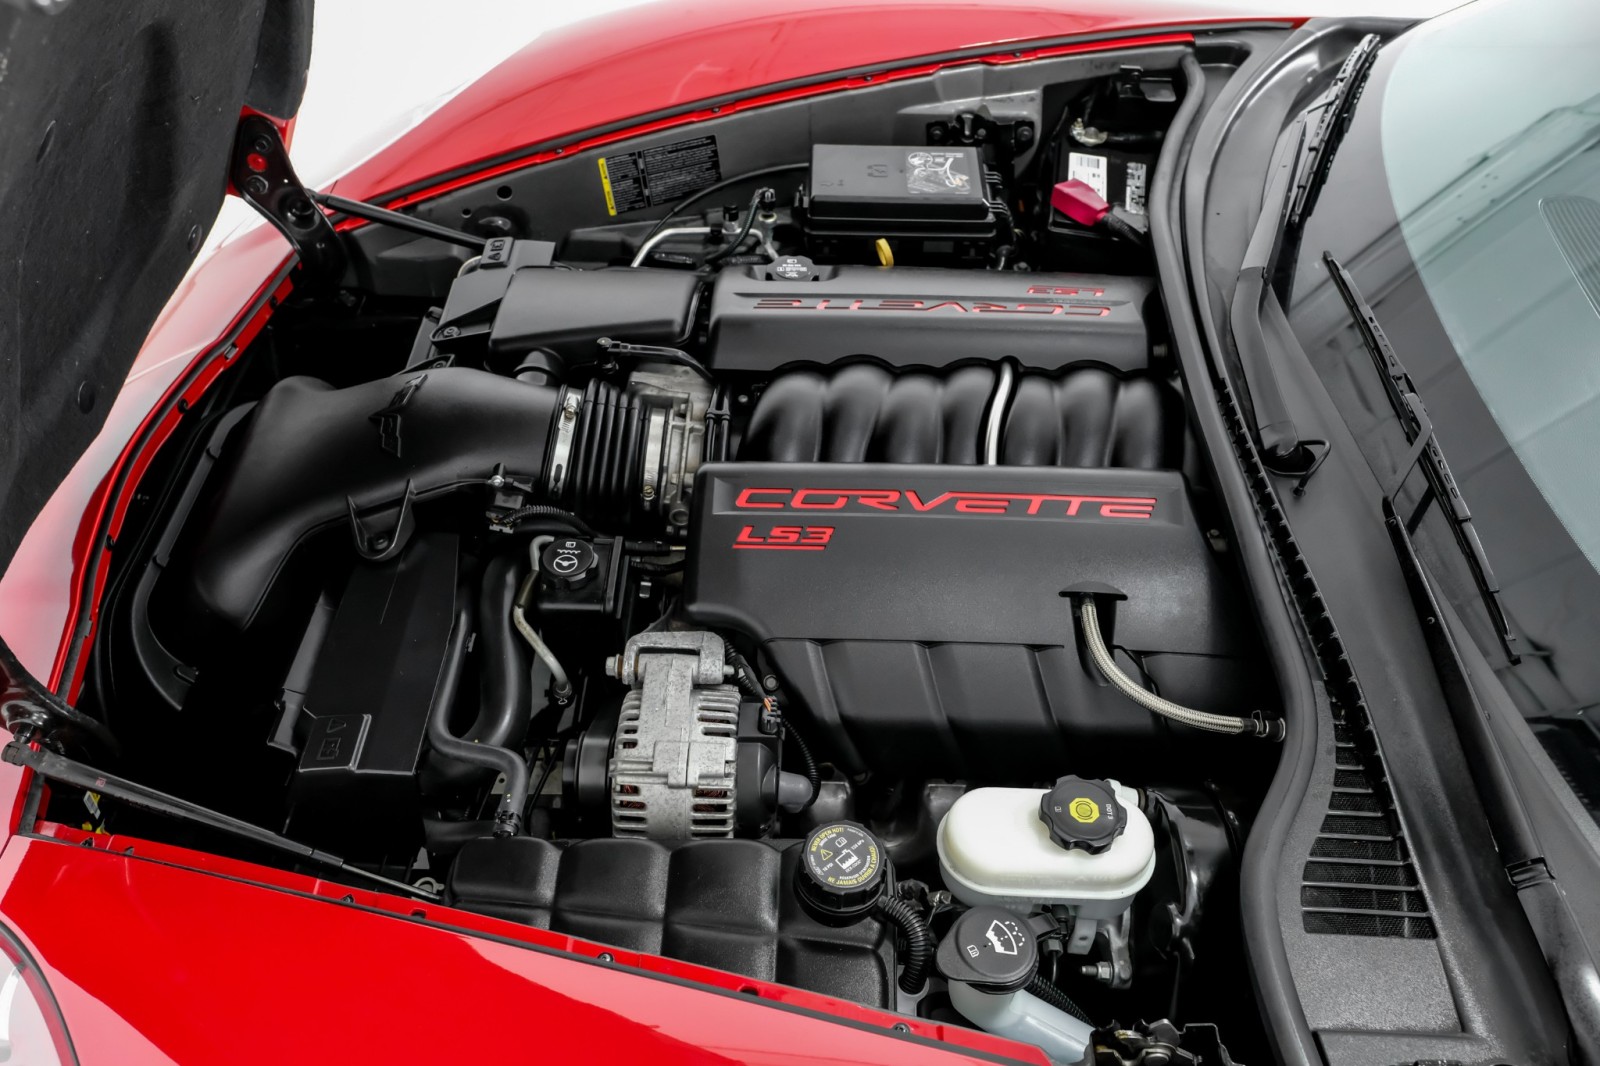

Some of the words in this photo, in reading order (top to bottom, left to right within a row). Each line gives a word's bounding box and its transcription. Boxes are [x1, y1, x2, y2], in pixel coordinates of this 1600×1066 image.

[1026, 285, 1107, 297] LS3
[753, 299, 1112, 317] CORVETTE
[734, 486, 1159, 519] CORVETTE
[732, 525, 836, 548] LS3
[811, 837, 820, 852] NEVER
[820, 829, 832, 839] OPEN
